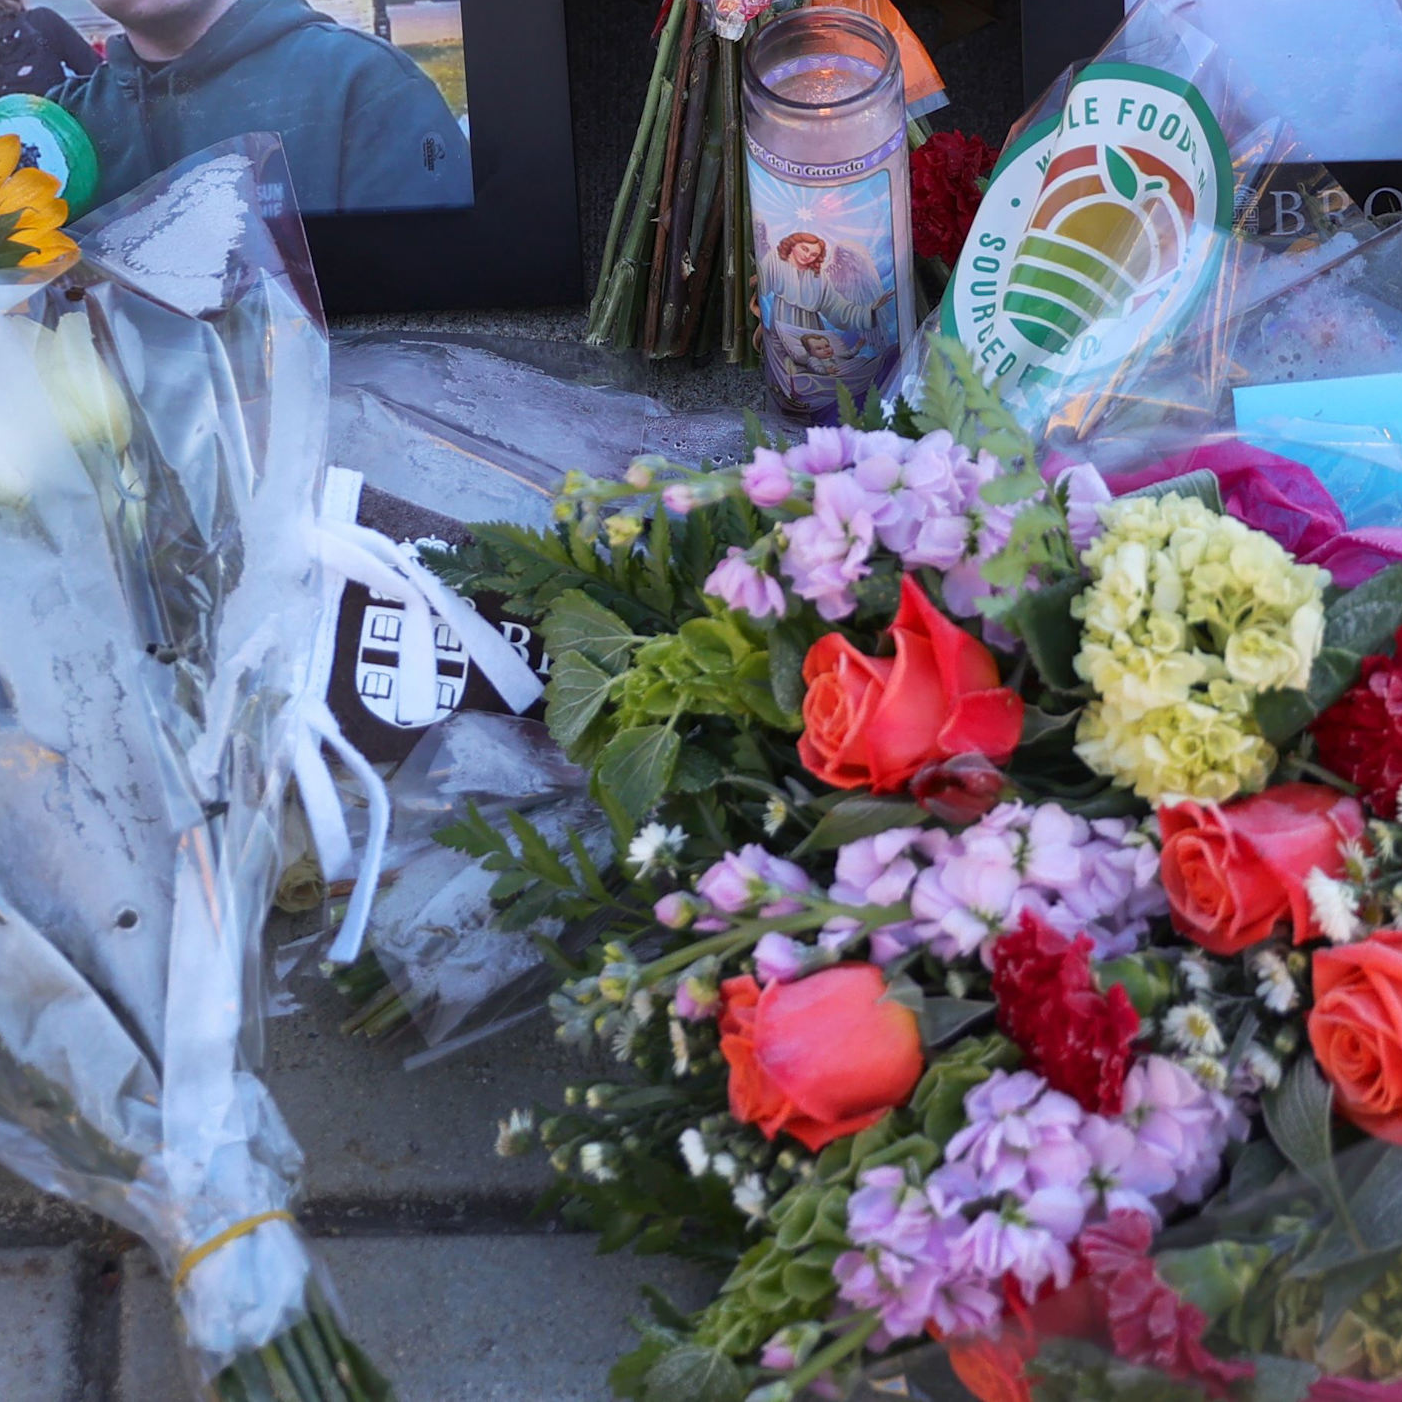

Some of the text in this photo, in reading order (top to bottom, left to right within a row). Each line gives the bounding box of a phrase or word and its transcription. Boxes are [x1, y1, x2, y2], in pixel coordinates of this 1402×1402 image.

[767, 155, 784, 169] de
[787, 161, 801, 175] la
[805, 159, 865, 176] Guarda
[970, 233, 1017, 378] SOURCED
